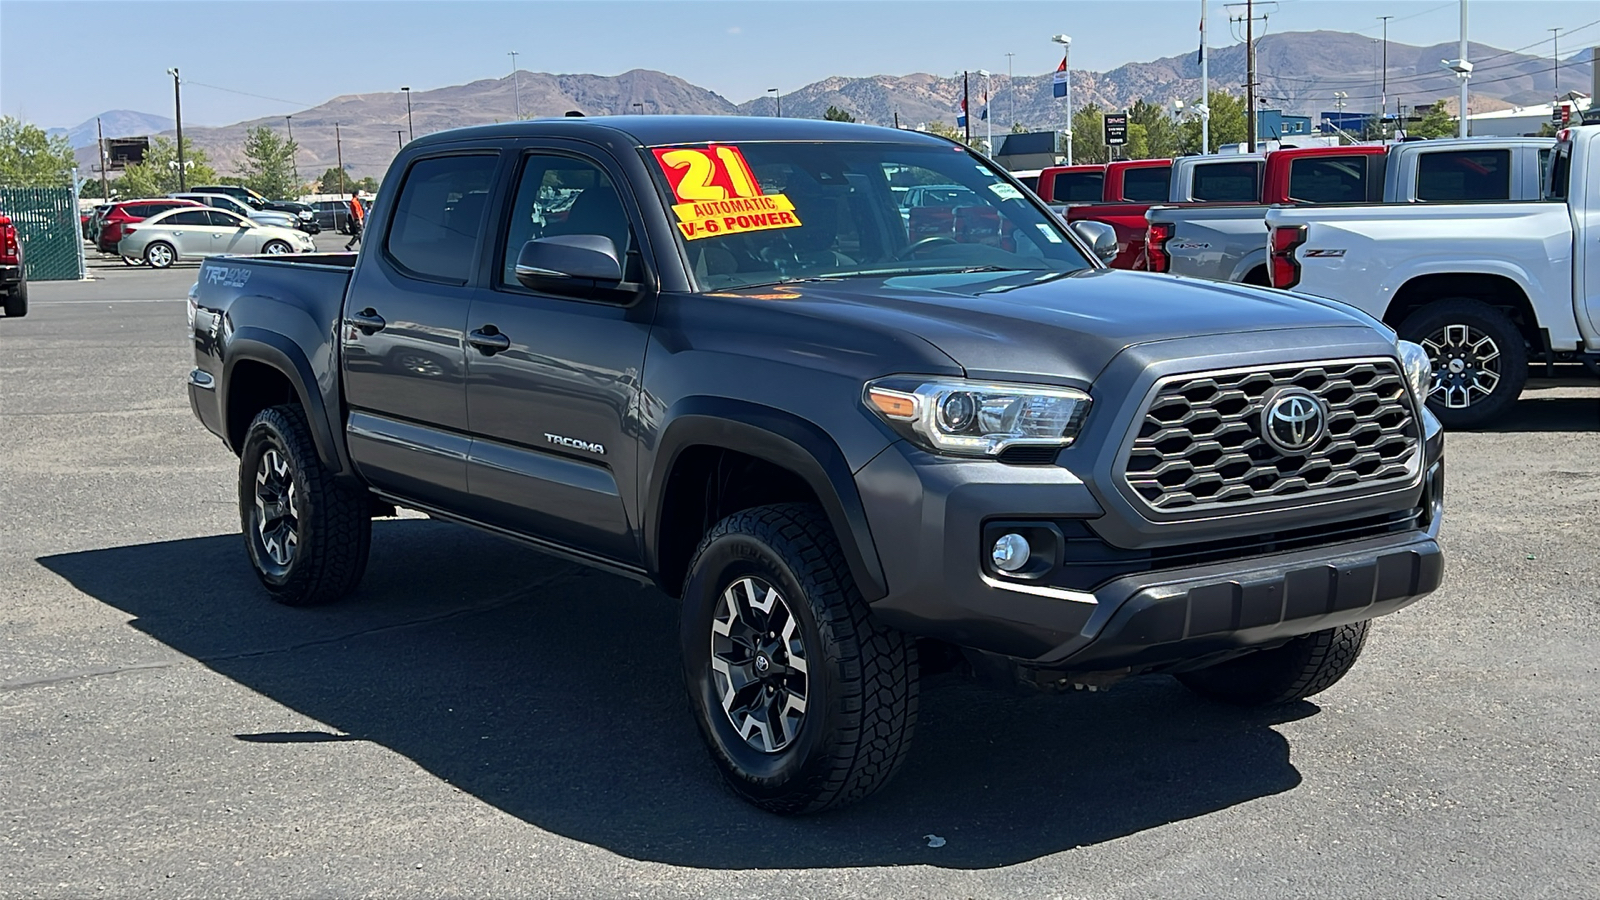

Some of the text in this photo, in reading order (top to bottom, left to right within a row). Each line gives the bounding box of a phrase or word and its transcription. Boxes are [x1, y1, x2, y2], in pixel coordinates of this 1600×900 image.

[661, 147, 758, 200] 21
[693, 196, 778, 218] AUTOMATIC
[681, 211, 796, 236] V-6 POWER
[1302, 249, 1347, 258] Z71
[205, 265, 229, 285] TRD
[544, 432, 605, 455] TACOMA
